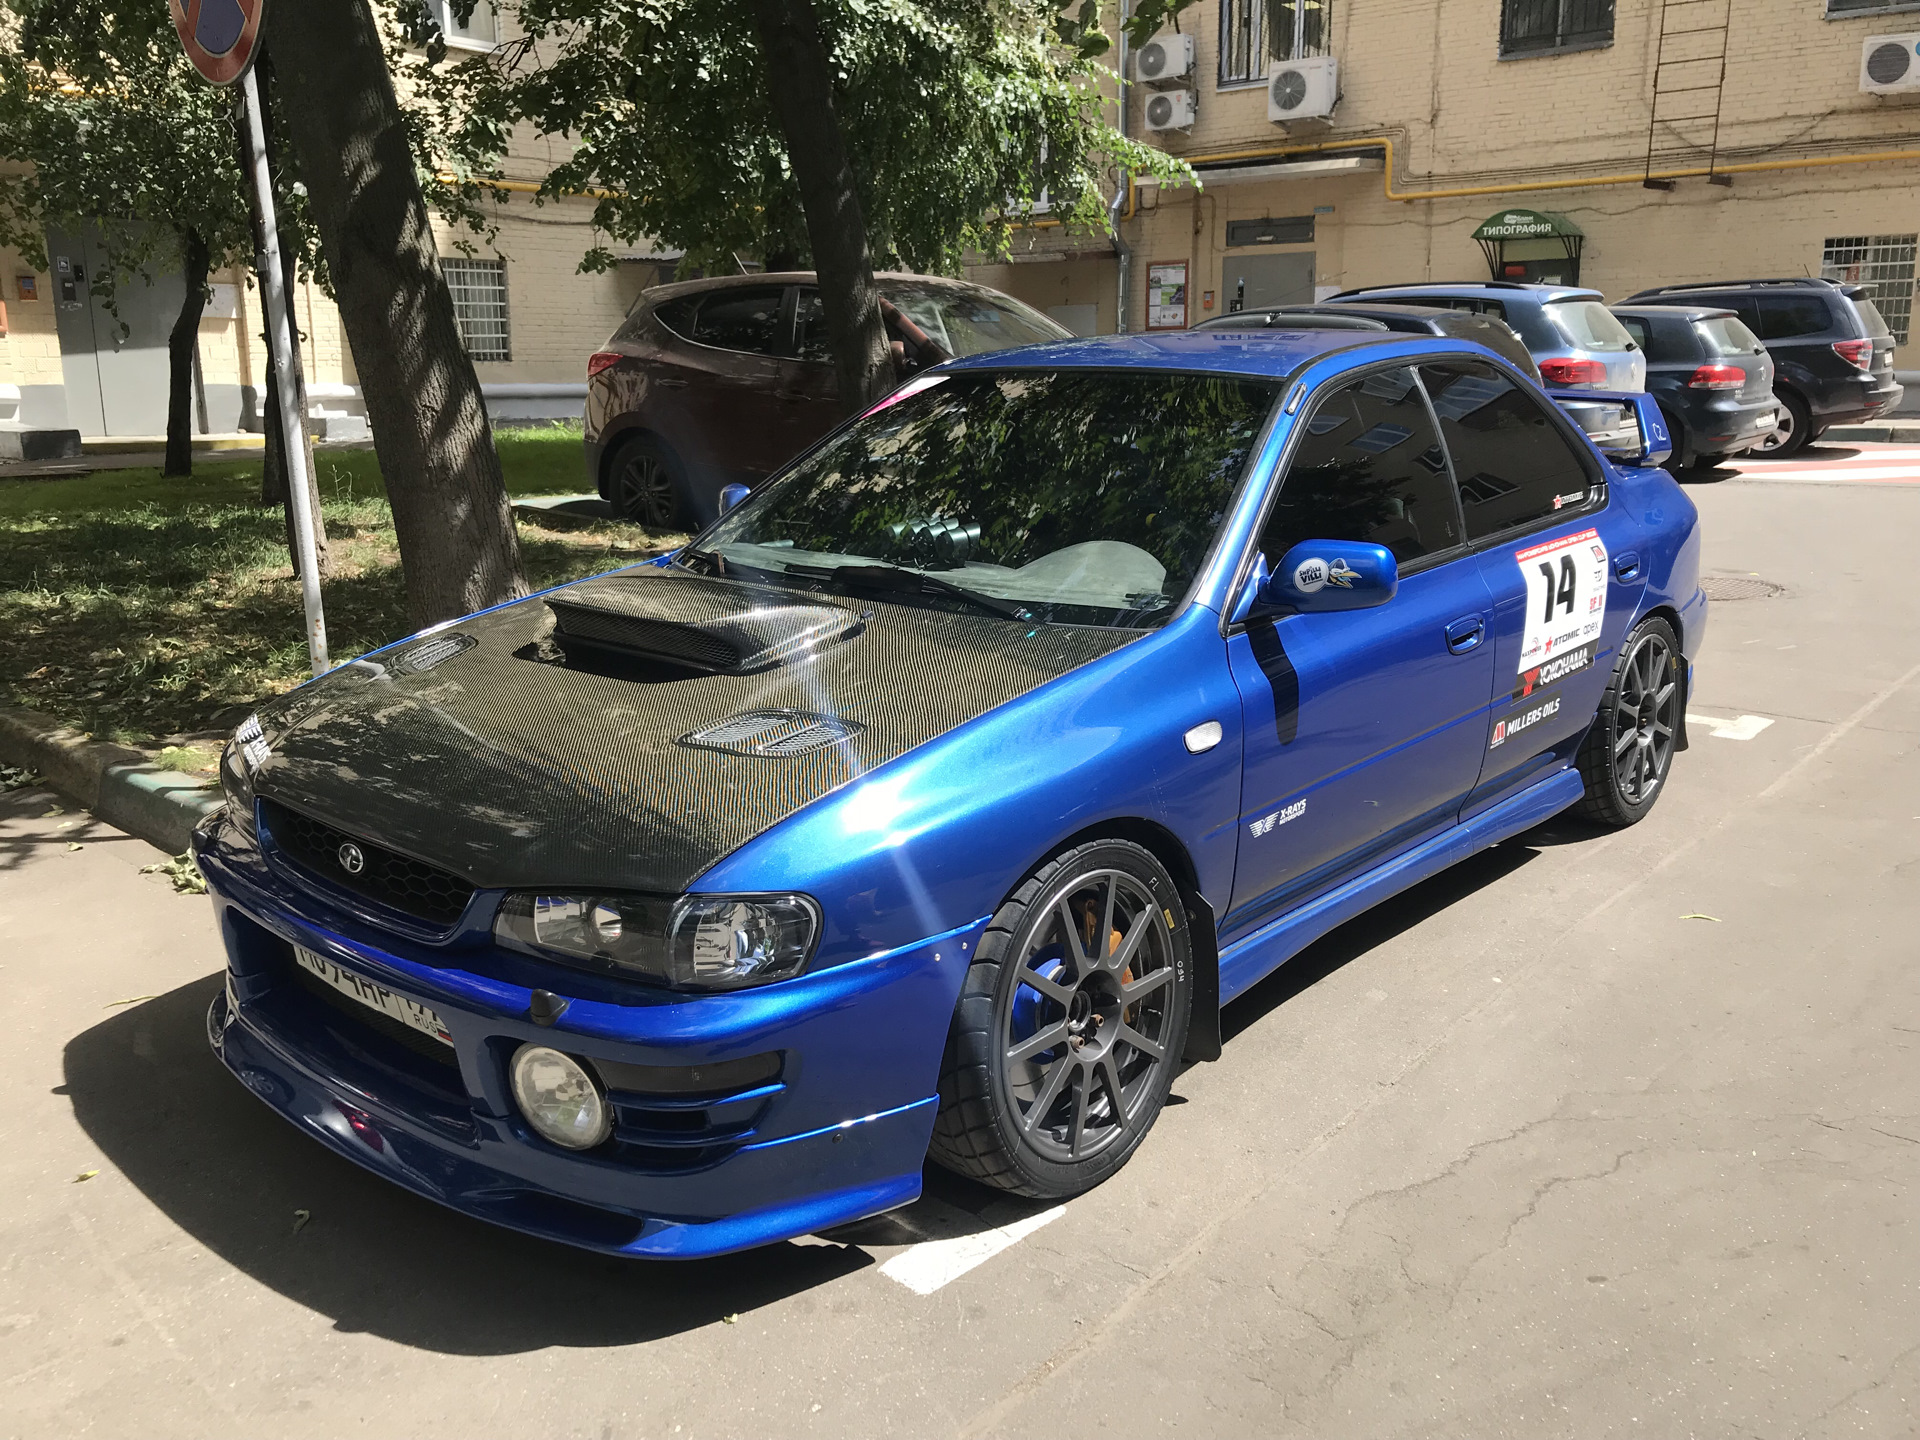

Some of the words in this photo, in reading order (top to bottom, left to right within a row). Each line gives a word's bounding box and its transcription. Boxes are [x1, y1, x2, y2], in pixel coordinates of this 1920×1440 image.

[1482, 223, 1552, 236] ТИПОГРАФИЯ
[1538, 554, 1577, 624] 14
[1553, 628, 1580, 648] ATOMIC
[1583, 621, 1599, 637] apex
[1539, 647, 1588, 686] YOKOHAMA
[1507, 706, 1542, 737] MILLERS
[1542, 697, 1561, 718] OILS
[1280, 798, 1307, 820] X-RAYS
[1148, 876, 1160, 892] FL
[413, 1013, 437, 1034] RUS
